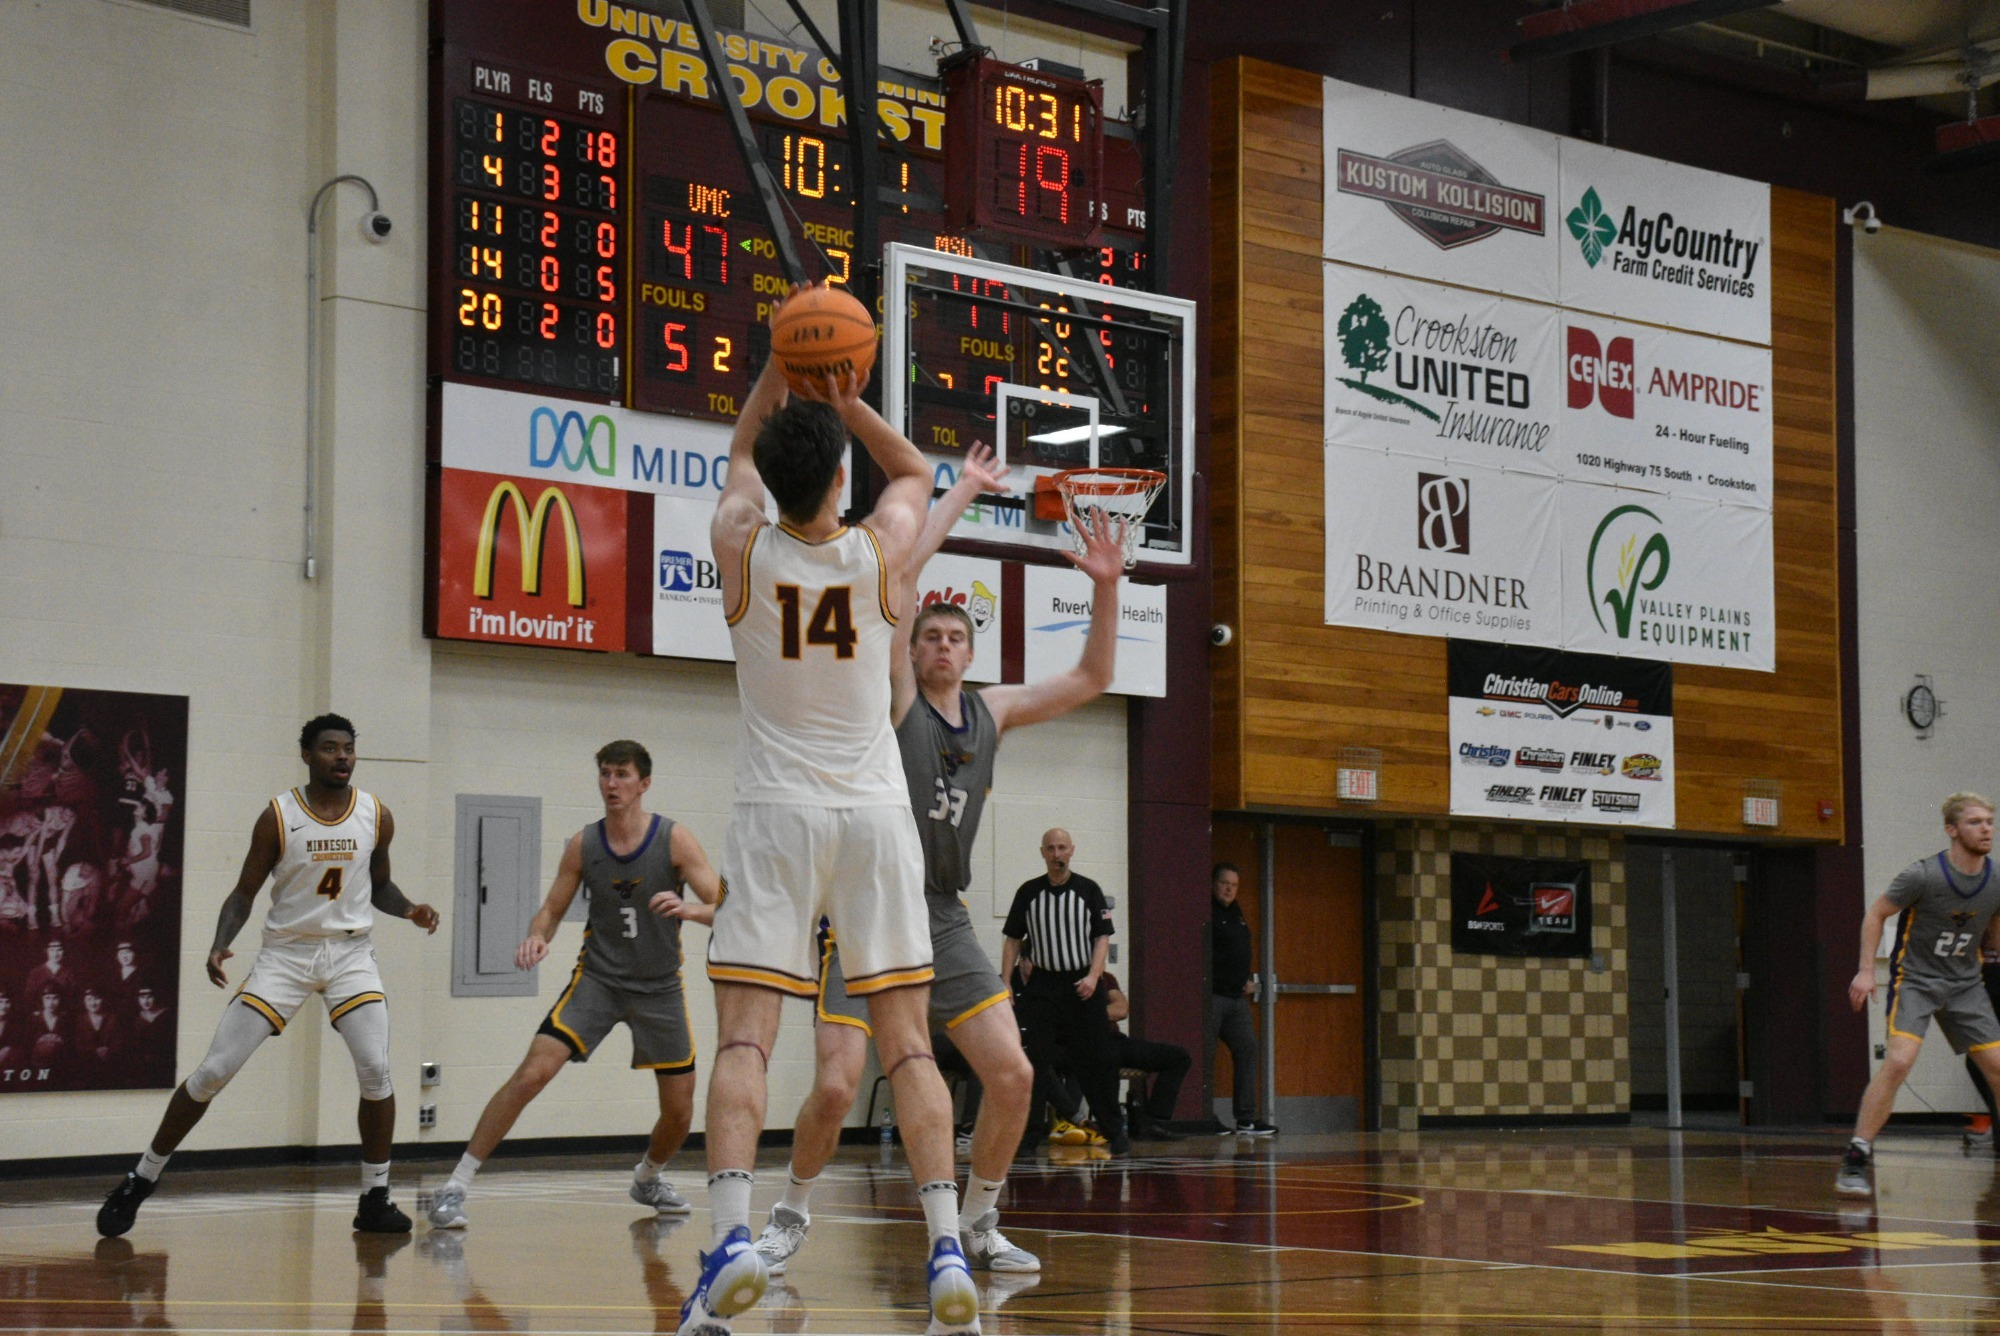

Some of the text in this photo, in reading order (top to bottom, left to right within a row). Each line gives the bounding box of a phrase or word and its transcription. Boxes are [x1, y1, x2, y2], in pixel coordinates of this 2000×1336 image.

[577, 0, 808, 74] UNIVESITY
[476, 66, 604, 115] PLYR FLS PTS
[996, 86, 1081, 143] 10:31
[541, 119, 561, 156] 2
[587, 131, 616, 169] 18
[483, 154, 616, 209] 4 3 7
[1019, 144, 1069, 224] 19
[1346, 160, 1536, 224] KUSTOM KOLLISION
[689, 183, 731, 218] UMC
[1127, 208, 1146, 229] PTS
[471, 201, 616, 258] 11 2 0
[1617, 205, 1759, 279] AgCountry
[664, 219, 729, 286] 47
[471, 246, 616, 302] 14 0 5
[1612, 250, 1755, 299] Farm Credit Services
[642, 284, 706, 313] FOULS
[459, 289, 615, 349] 20 2 0
[1394, 305, 1518, 364] Crookston
[664, 322, 731, 372] 5 2
[960, 336, 1016, 361] FOULS
[1395, 351, 1530, 410] UNITED
[1569, 353, 1760, 412] CENEX AMPRIDE
[708, 393, 739, 416] TOL
[931, 426, 960, 447] TOL
[1436, 401, 1550, 453] Insurance
[1655, 425, 1670, 438] 24
[1680, 428, 1706, 445] Hour
[1709, 434, 1750, 455] Fueling
[1576, 453, 1757, 492] 1020 Highway 75 South Crookston
[660, 554, 693, 567] BREMER
[659, 592, 692, 602] BANKING
[1355, 553, 1530, 610] BRANDNER
[469, 607, 594, 643] i'm lovin' it
[775, 582, 858, 660] 14
[1122, 605, 1164, 624] Health
[1354, 596, 1532, 631] Printing & Office Supplies
[1639, 599, 1751, 627] VALLEY PLAINS
[1640, 620, 1751, 652] EQUIPMENT
[1499, 710, 1522, 719] GMC
[1524, 712, 1555, 721] POLARIS
[1459, 742, 1511, 760] Christian
[1570, 751, 1617, 768] FINLEY
[1487, 784, 1532, 799] FINLEY
[1539, 785, 1588, 803] FINLEY
[306, 838, 358, 853] MINNESOTA
[316, 866, 344, 901] 4
[619, 906, 639, 939] 3
[1933, 931, 1974, 958] 22
